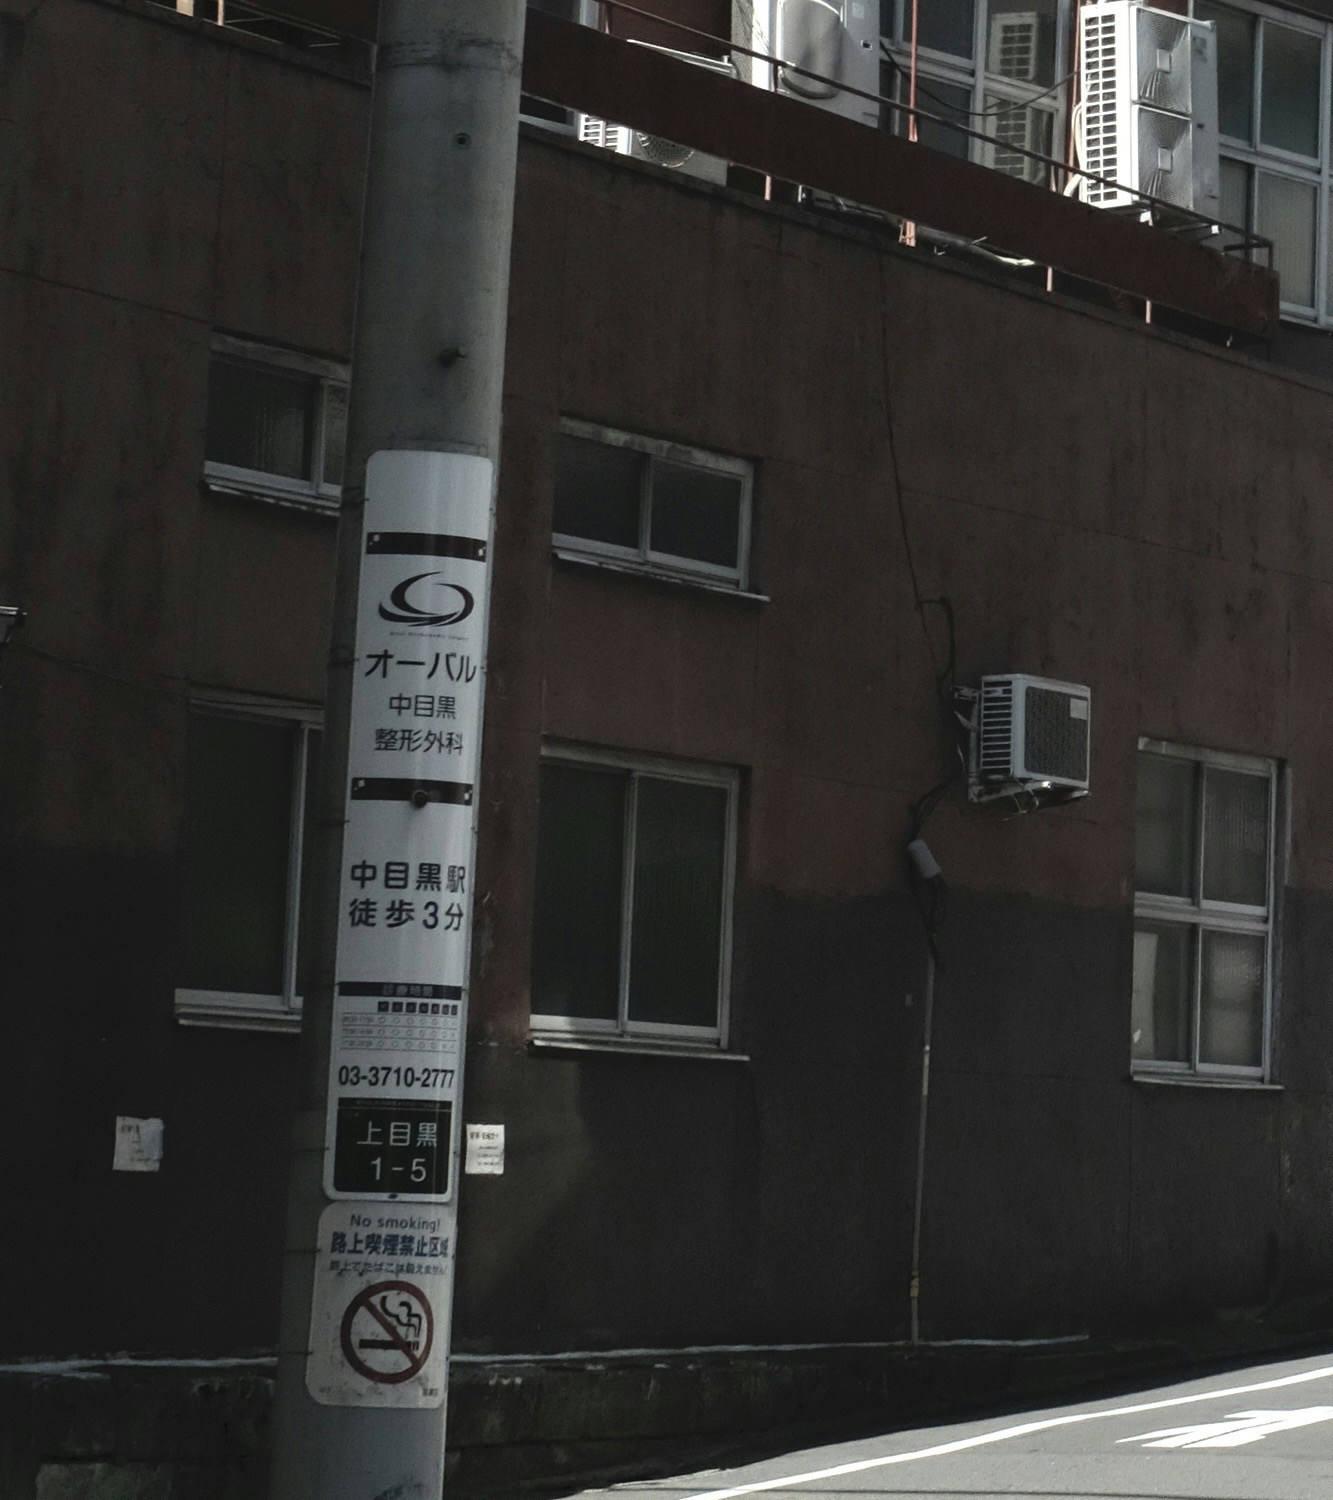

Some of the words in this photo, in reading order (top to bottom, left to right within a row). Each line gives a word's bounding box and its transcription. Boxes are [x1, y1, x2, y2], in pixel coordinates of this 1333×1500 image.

[365, 649, 477, 684] オーバル
[389, 693, 457, 719] 中目黒
[374, 727, 464, 756] 整形外科
[351, 859, 466, 894] 中目黒駅
[350, 898, 465, 931] 徒歩3分
[338, 1065, 455, 1088] 03-3710-2777
[356, 1120, 438, 1149] 上目黒
[370, 1157, 427, 1183] 1-5
[350, 1214, 372, 1228] No
